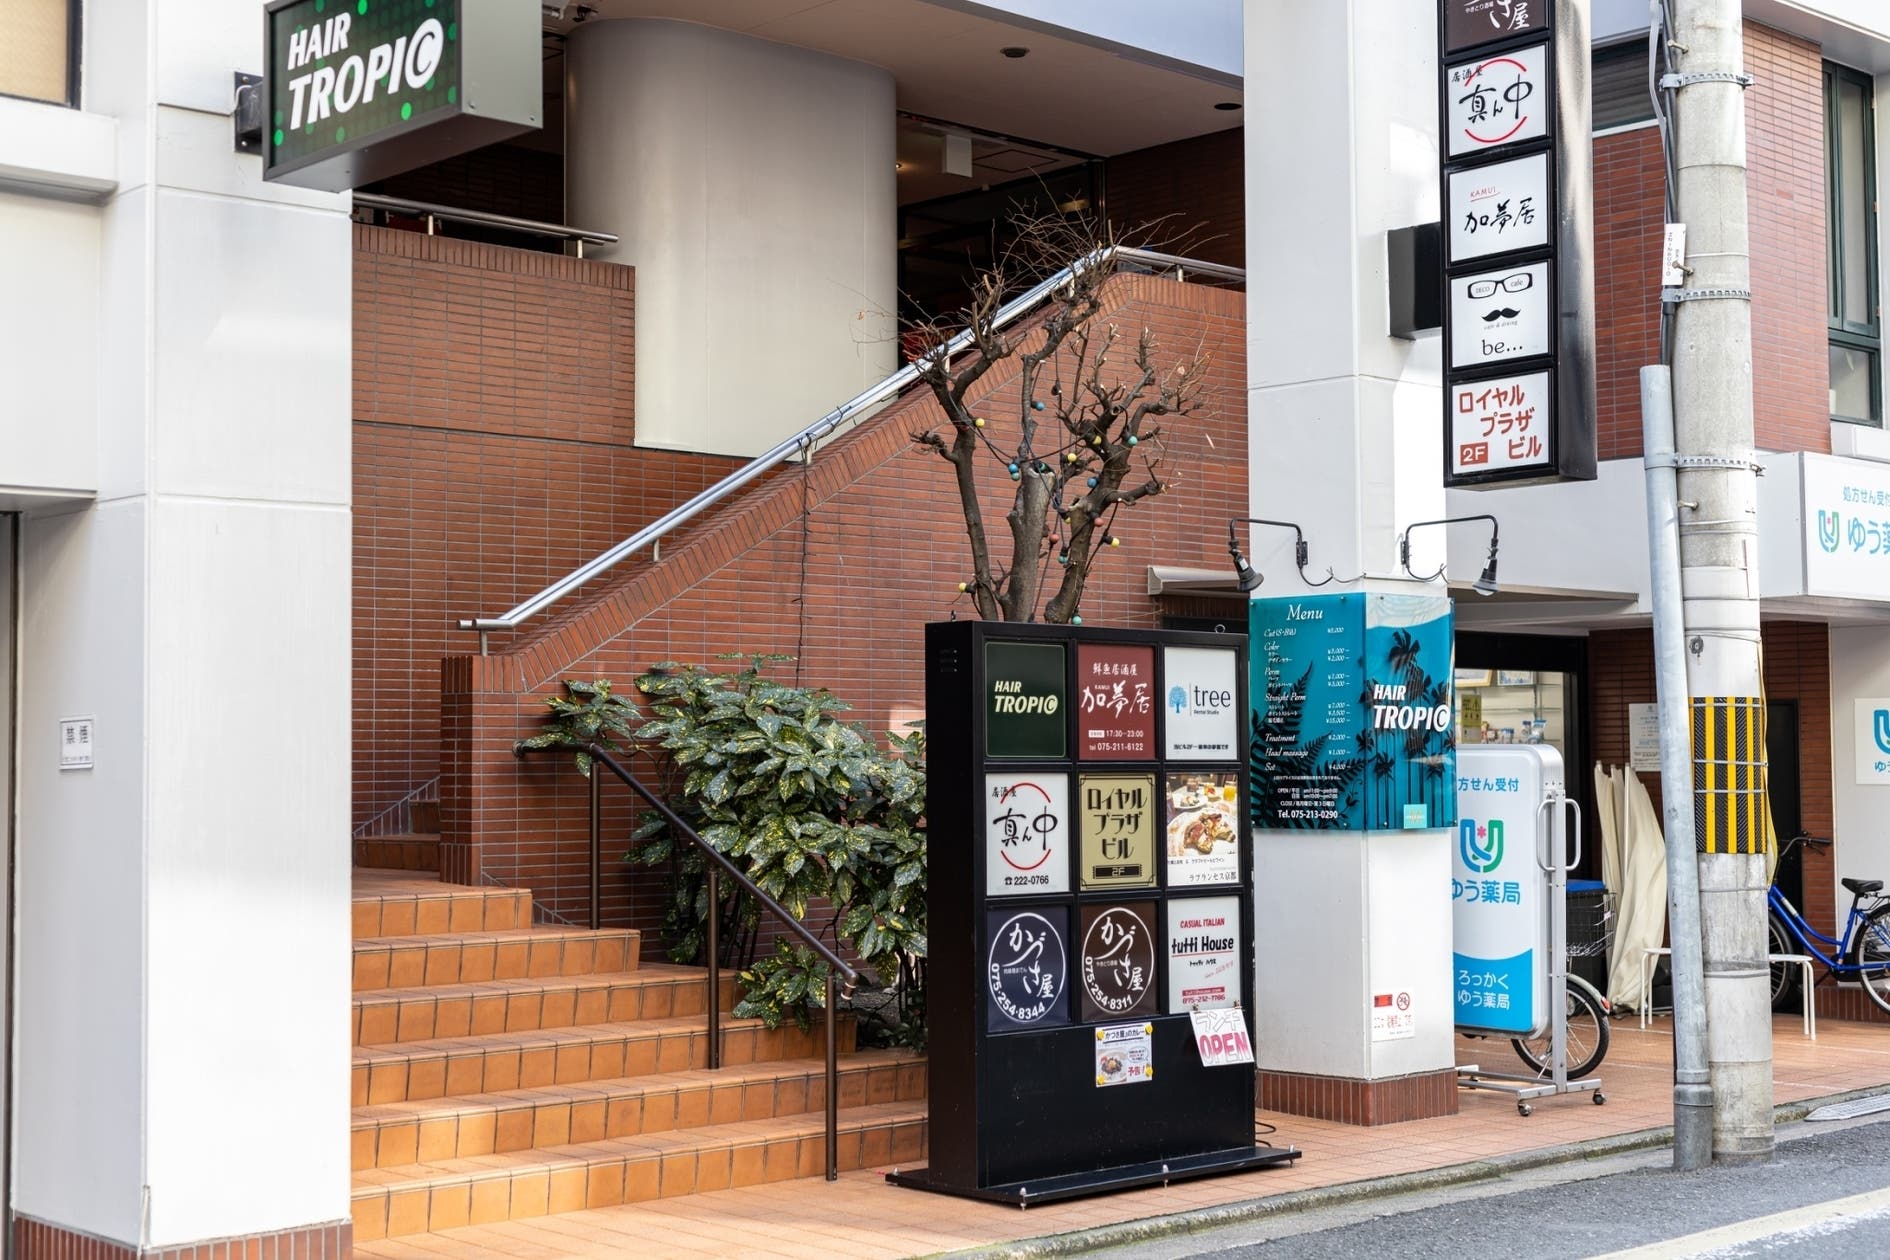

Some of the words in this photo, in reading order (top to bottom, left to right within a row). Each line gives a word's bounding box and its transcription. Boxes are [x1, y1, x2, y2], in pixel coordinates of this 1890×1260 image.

[288, 12, 351, 70] HAIR
[288, 18, 444, 130] TROPIC
[1459, 73, 1533, 124] 真ん中
[1470, 187, 1497, 198] KAMUI
[1464, 197, 1536, 234] 加夢居
[1459, 384, 1525, 414] ロイヤル
[1480, 406, 1536, 437] プラザ
[1462, 445, 1487, 463] 2F
[1508, 435, 1543, 460] ビル
[1286, 603, 1323, 621] Menu
[1093, 662, 1138, 676] 鮮魚居酒屋
[994, 680, 1022, 693] HAIR
[1193, 685, 1231, 708] tree
[1373, 683, 1407, 701] HAIR
[994, 694, 1059, 715] TROPIC
[1081, 680, 1151, 719] 加夢居
[1373, 704, 1451, 732] TROPIC
[1097, 742, 1144, 751] 075-211-6122
[1265, 733, 1296, 742] Treatment
[1265, 746, 1282, 757] Head
[1282, 749, 1309, 759] massage
[1264, 762, 1276, 771] Set
[1087, 788, 1147, 810] ロイヤル
[1093, 811, 1143, 835] プラザ
[1290, 809, 1339, 819] 075-213-0290
[993, 805, 1058, 851] 真ん中
[1102, 838, 1135, 860] ビル
[1014, 875, 1049, 886] 222-0766
[1112, 867, 1125, 876] 2F
[1180, 919, 1202, 929] CASUAL
[1203, 917, 1225, 927] ITALIAN
[1171, 936, 1198, 954] tutti
[1201, 935, 1235, 952] House
[1458, 970, 1509, 990] ろっかく
[1457, 989, 1510, 1010] ゆう薬局
[1199, 1031, 1251, 1062] OPEN
